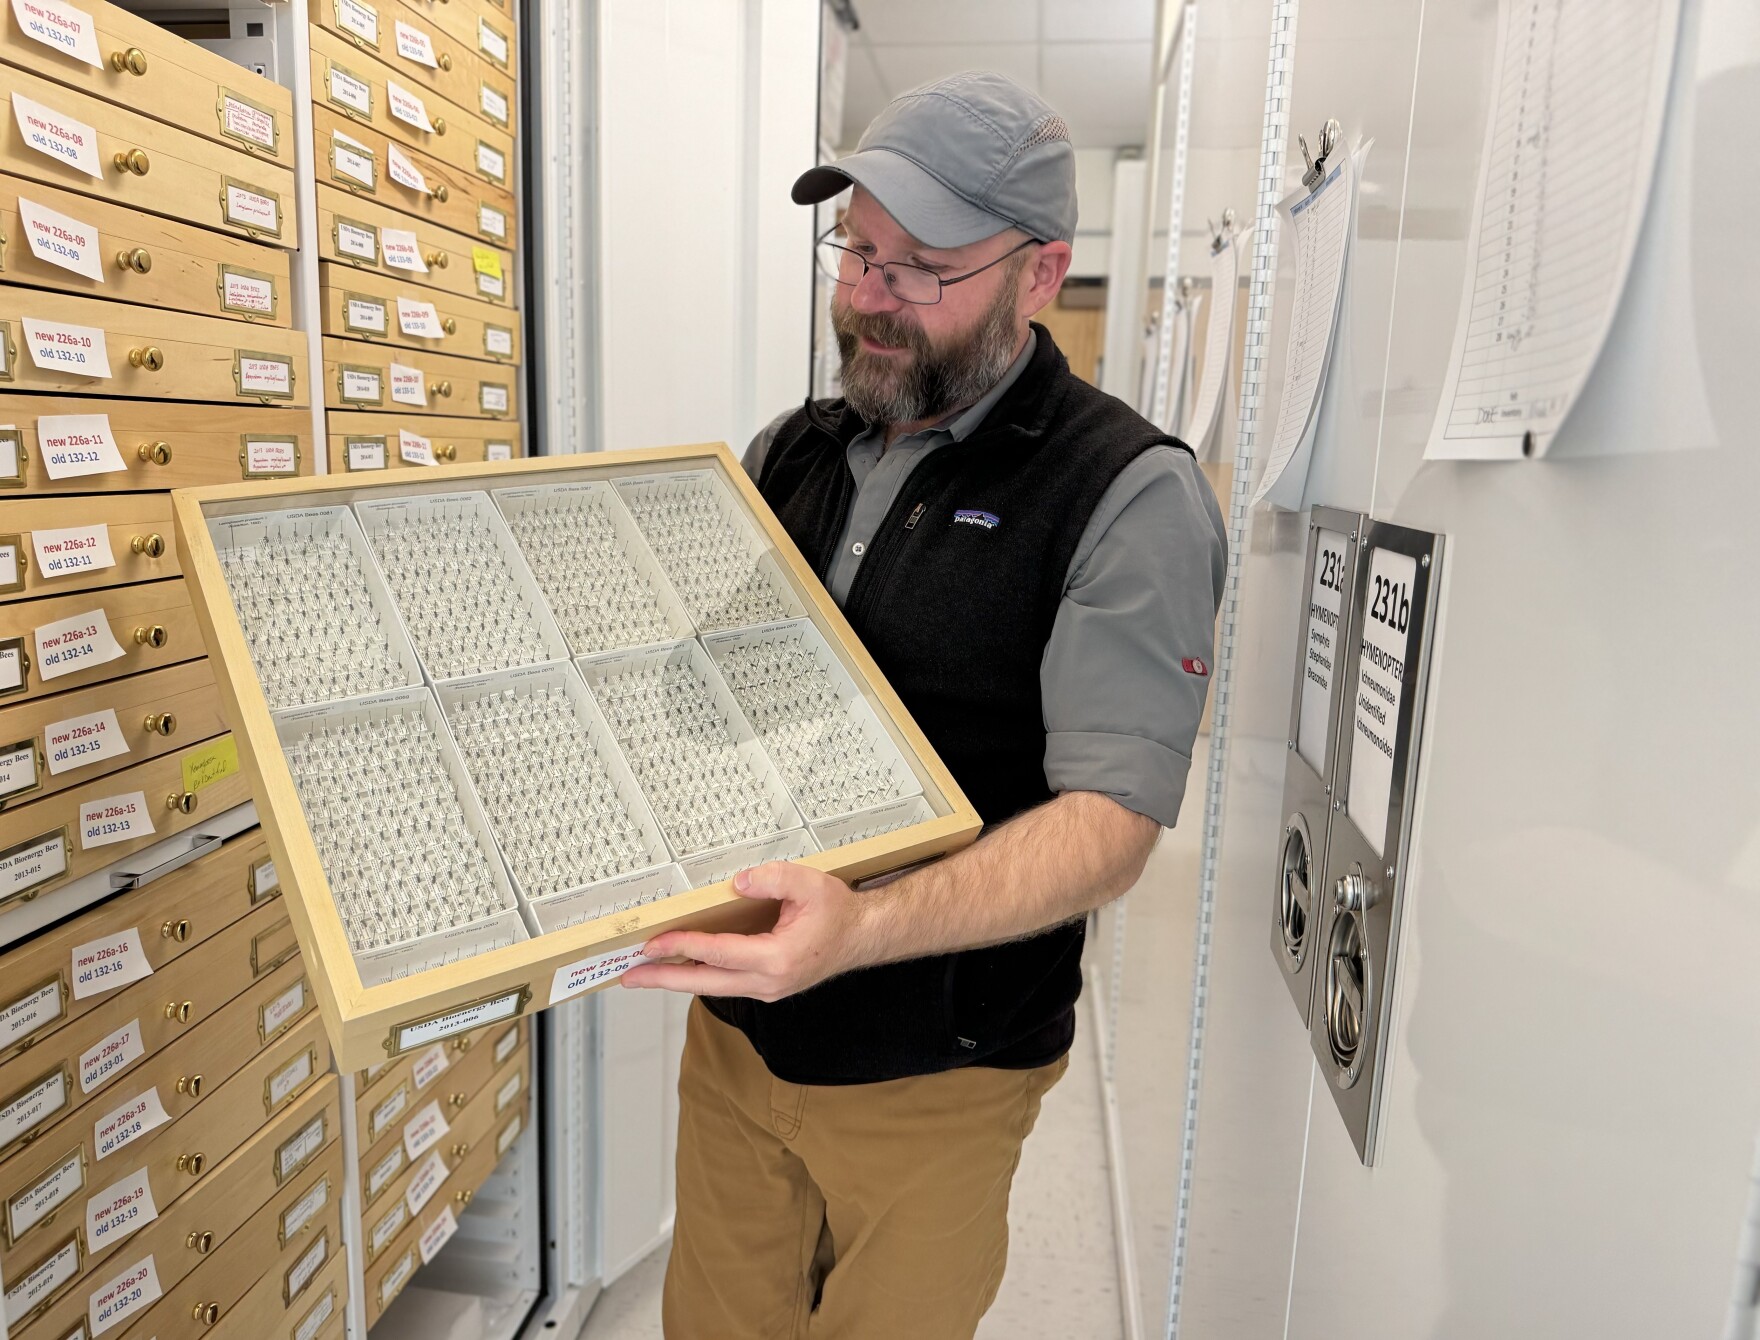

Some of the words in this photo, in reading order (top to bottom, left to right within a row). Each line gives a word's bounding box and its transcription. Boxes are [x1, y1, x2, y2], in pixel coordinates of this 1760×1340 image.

[24, 2, 44, 19] new
[45, 10, 81, 34] 226a-07
[30, 21, 45, 33] old
[47, 27, 76, 47] 132-07
[27, 116, 47, 130] new
[48, 123, 84, 146] 226a-08
[32, 133, 48, 146] old
[49, 139, 78, 160] 132-08
[32, 220, 51, 234] new
[53, 226, 86, 247] 226a-09
[37, 237, 51, 249] old
[52, 242, 80, 260] 132-09
[34, 331, 55, 343] new
[56, 332, 92, 348] 226a-10
[40, 347, 55, 359] old
[57, 349, 86, 363] 132-10
[46, 437, 67, 448] new
[68, 434, 104, 447] 226a-11
[51, 453, 67, 465] old
[68, 451, 100, 464] 132-12
[954, 515, 992, 529] patagonia
[43, 543, 63, 554] new
[63, 536, 97, 551] 226a-12
[48, 559, 63, 570] old
[64, 555, 92, 568] 132-11
[1371, 574, 1410, 635] 231b
[42, 638, 61, 650] new
[62, 625, 98, 644] 226a-13
[44, 653, 61, 667] old
[61, 643, 94, 661] 132-14
[1361, 668, 1396, 707] Ichneumonidae
[1358, 692, 1387, 726] Unidentified
[51, 733, 71, 745] new
[71, 721, 107, 739] 226a-14
[1356, 715, 1393, 760] Ichneumonoidea
[15, 753, 29, 762] Bees
[54, 748, 69, 762] old
[69, 739, 101, 757] 132-15
[86, 811, 103, 822] new
[105, 803, 137, 819] 226a-15
[87, 826, 101, 838] old
[102, 820, 131, 835] 132-13
[14, 849, 45, 866] Bioenergy
[45, 843, 59, 853] Bees
[14, 864, 41, 881] 2013-015
[77, 956, 96, 968] new
[96, 942, 129, 961] 226a-16
[78, 970, 93, 984] old
[94, 960, 124, 979] 132-16
[567, 977, 586, 990] old
[590, 962, 630, 980] 132-06
[570, 964, 597, 978] new
[10, 996, 39, 1016] Bioenergy
[41, 987, 54, 998] Bees
[410, 1020, 438, 1032] USDA
[441, 1004, 486, 1022] Bioenergy
[490, 997, 510, 1006] Bees
[11, 1011, 37, 1031] 2013-016
[438, 1015, 479, 1031] 2013-006
[84, 1054, 100, 1070] new
[101, 1033, 131, 1058] 226a-17
[85, 1071, 98, 1085] old
[99, 1053, 125, 1076] 133-01
[16, 1087, 45, 1110] Bioenergy
[46, 1077, 59, 1089] Bees
[100, 1124, 117, 1139] new
[117, 1101, 147, 1126] 226a-18
[101, 1140, 115, 1154] old
[115, 1121, 142, 1142] 132-18
[15, 1193, 34, 1211] USDA
[34, 1172, 62, 1196] Bioenergy
[62, 1161, 75, 1174] Bees
[95, 1208, 112, 1222] new
[112, 1187, 144, 1211] 226a-19
[95, 1222, 110, 1237] old
[111, 1206, 138, 1229] 132-19
[28, 1258, 57, 1284] Bioenergy
[57, 1247, 71, 1261] Bees
[97, 1292, 116, 1308] new
[116, 1267, 149, 1296] 226a-20
[98, 1307, 113, 1323] old
[113, 1287, 142, 1312] 132-20
